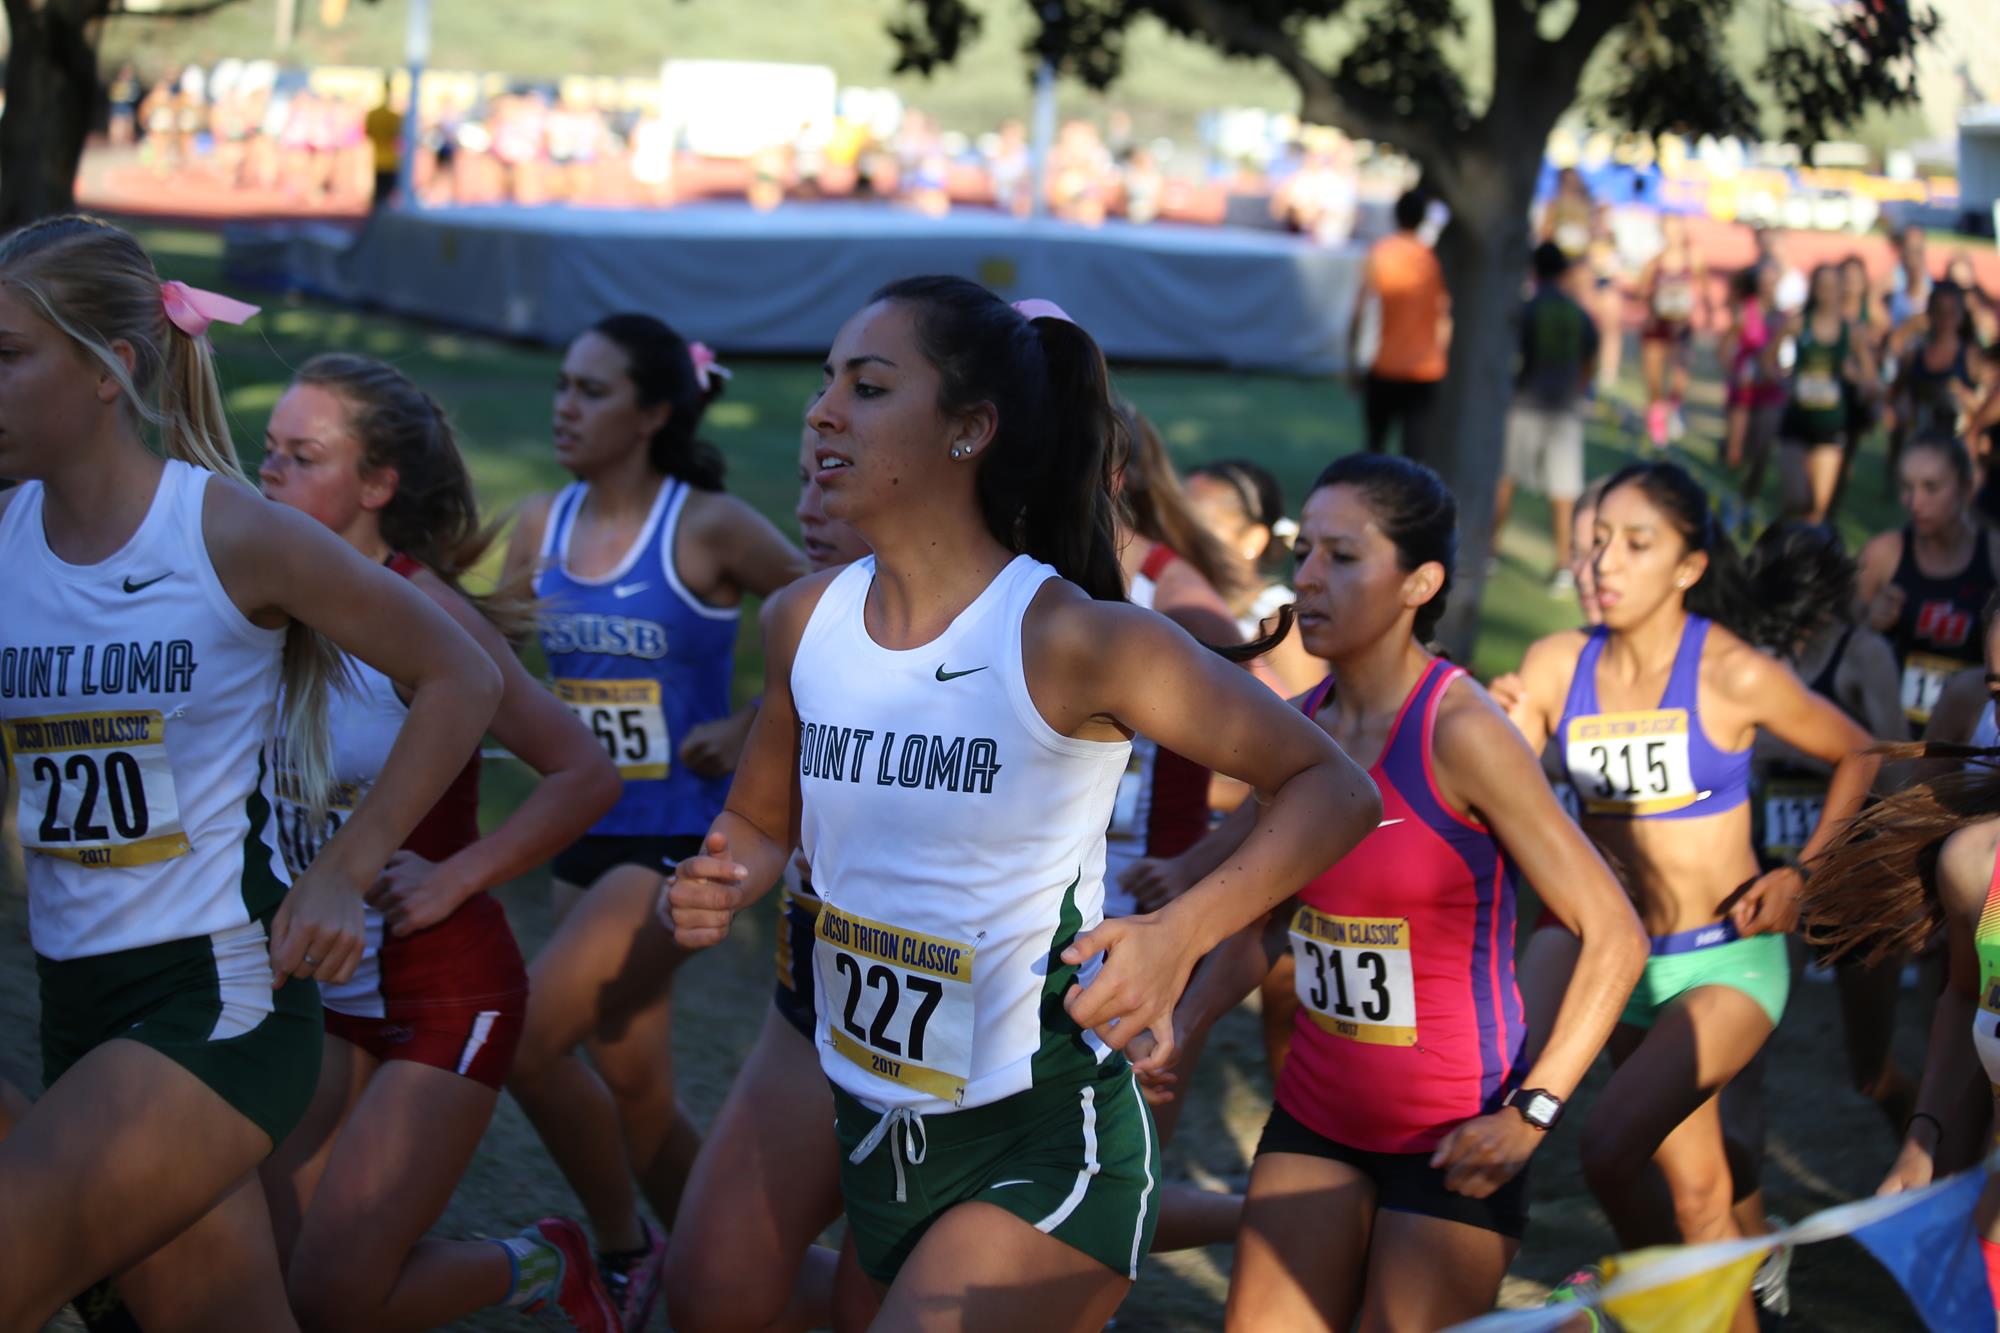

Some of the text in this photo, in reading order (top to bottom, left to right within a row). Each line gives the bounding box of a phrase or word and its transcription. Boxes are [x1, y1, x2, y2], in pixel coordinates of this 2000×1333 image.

[0, 639, 198, 698] OINT LOMA
[43, 719, 91, 747] TRITON
[92, 714, 150, 744] CLASSIC
[571, 708, 649, 761] 65
[876, 731, 1003, 794] LOMA
[1590, 742, 1671, 797] 315
[32, 751, 149, 842] 220
[78, 848, 113, 864] 2017
[822, 910, 961, 976] UCSD TRITON CLASSIC
[1348, 923, 1400, 945] CLASSIC
[835, 952, 944, 1062] 227
[1304, 940, 1391, 1022] 313
[871, 1054, 902, 1079] 2017
